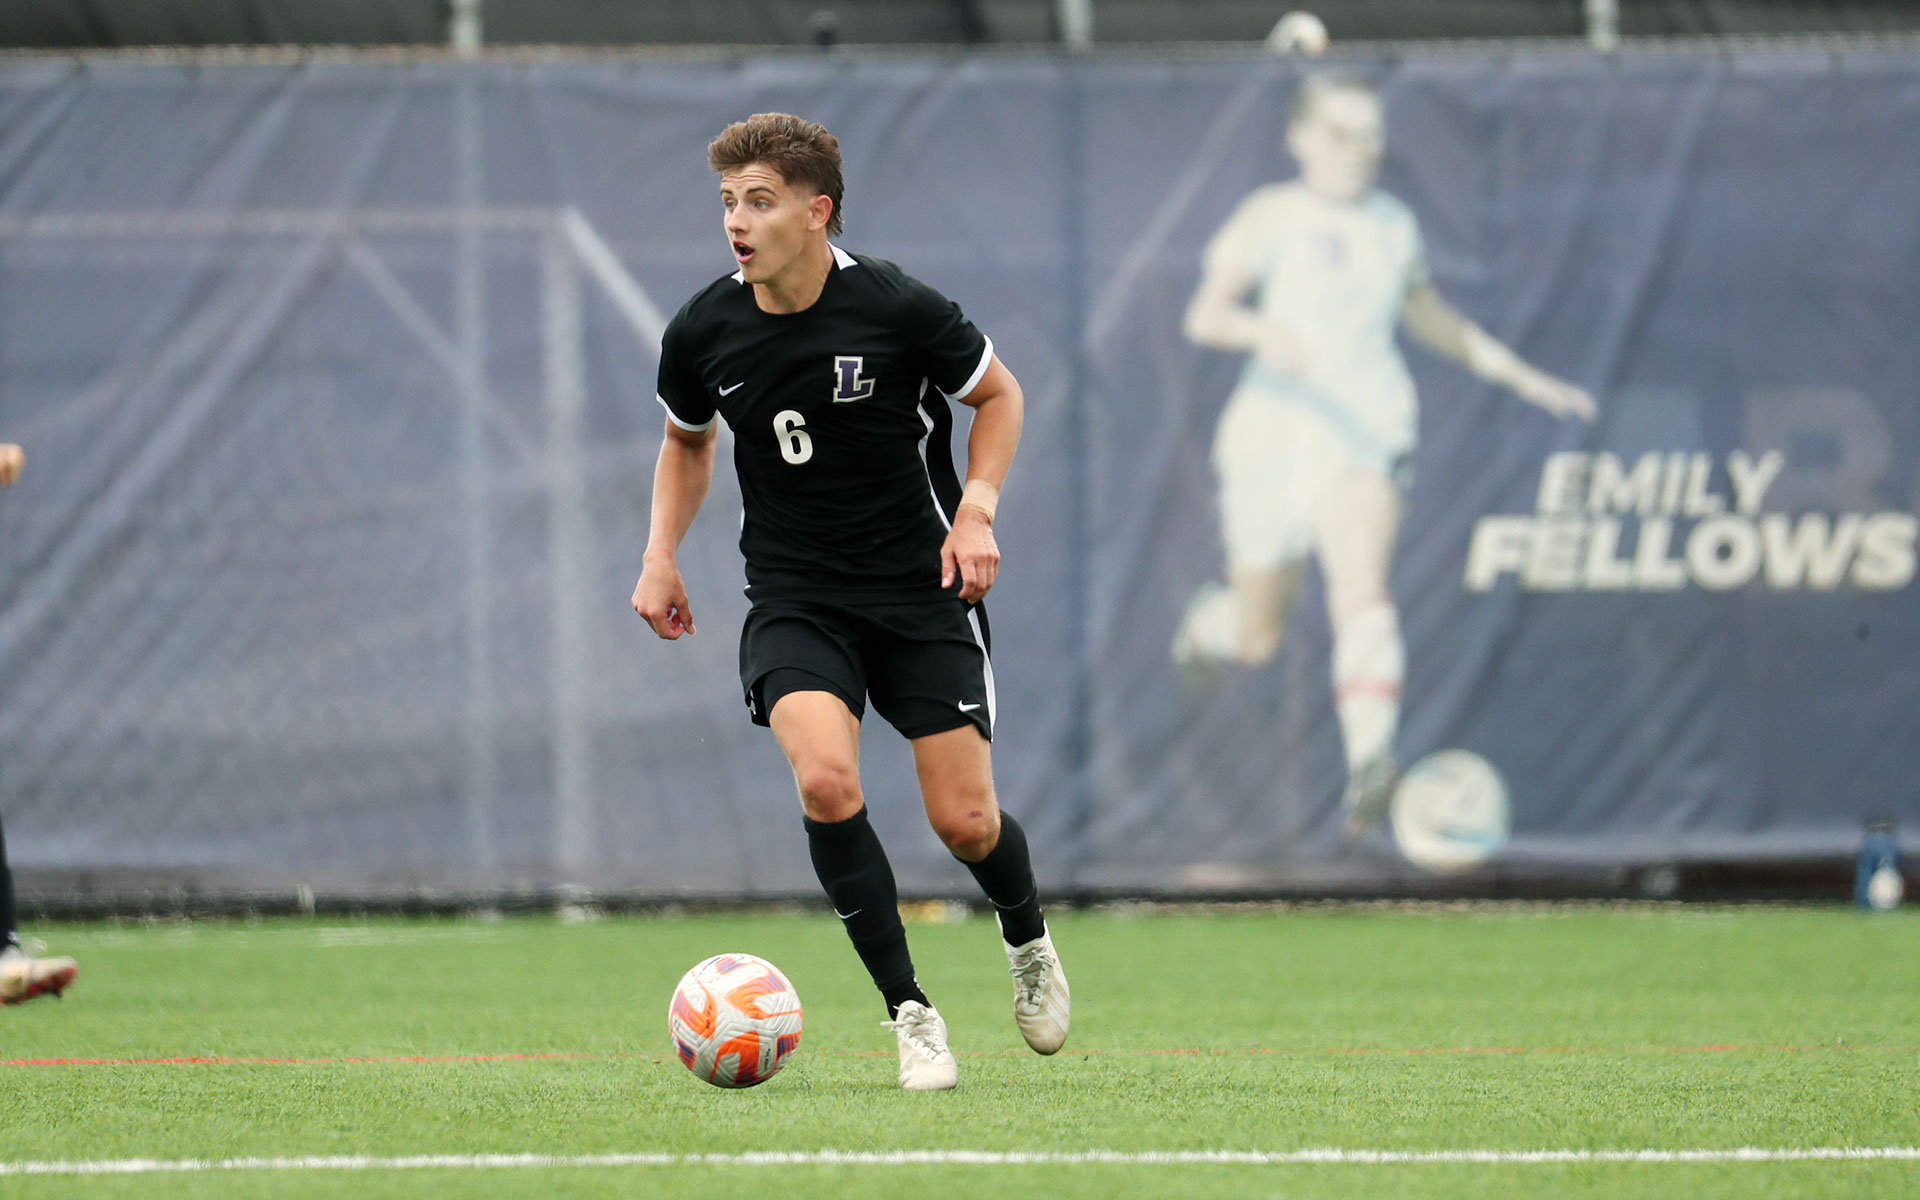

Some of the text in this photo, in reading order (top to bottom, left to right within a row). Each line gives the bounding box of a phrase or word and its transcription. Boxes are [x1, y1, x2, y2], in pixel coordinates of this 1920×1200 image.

[833, 355, 876, 403] L
[773, 409, 813, 465] 6
[1536, 449, 1784, 516] EMILY
[1464, 511, 1919, 592] FELLOWS
